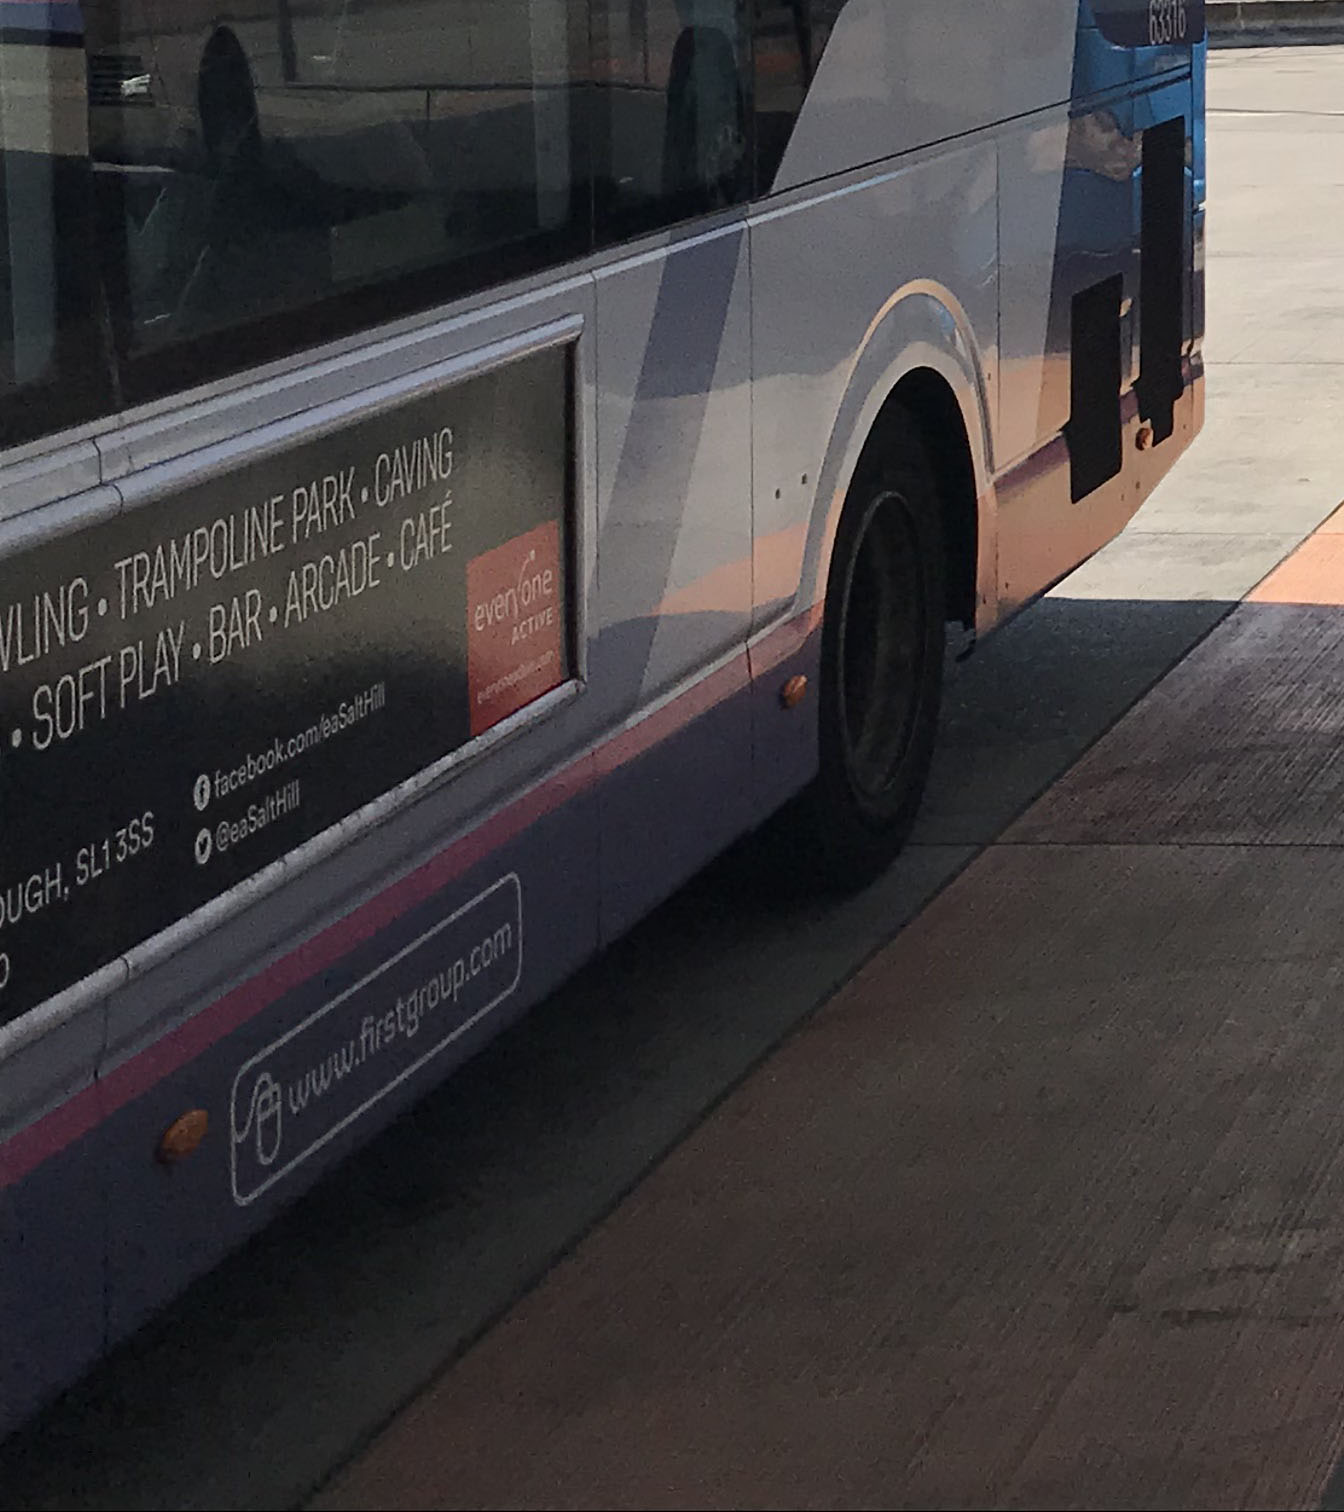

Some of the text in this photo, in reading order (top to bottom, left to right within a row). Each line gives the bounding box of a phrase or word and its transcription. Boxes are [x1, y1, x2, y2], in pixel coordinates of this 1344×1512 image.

[115, 495, 285, 620] TRAMPOLINE
[292, 466, 356, 544] PARK
[374, 427, 454, 508] CAVING
[33, 489, 453, 751] SOFT PLAY BAR ARCADE CAFÉ
[511, 606, 554, 646] ACTIVE
[214, 681, 386, 799] facebook.com/eaSaltHill
[76, 838, 111, 886] SL1
[115, 811, 155, 863] 3SS
[215, 778, 300, 853] @eaSaltHill
[289, 922, 512, 1116] www.firstgroup.com
